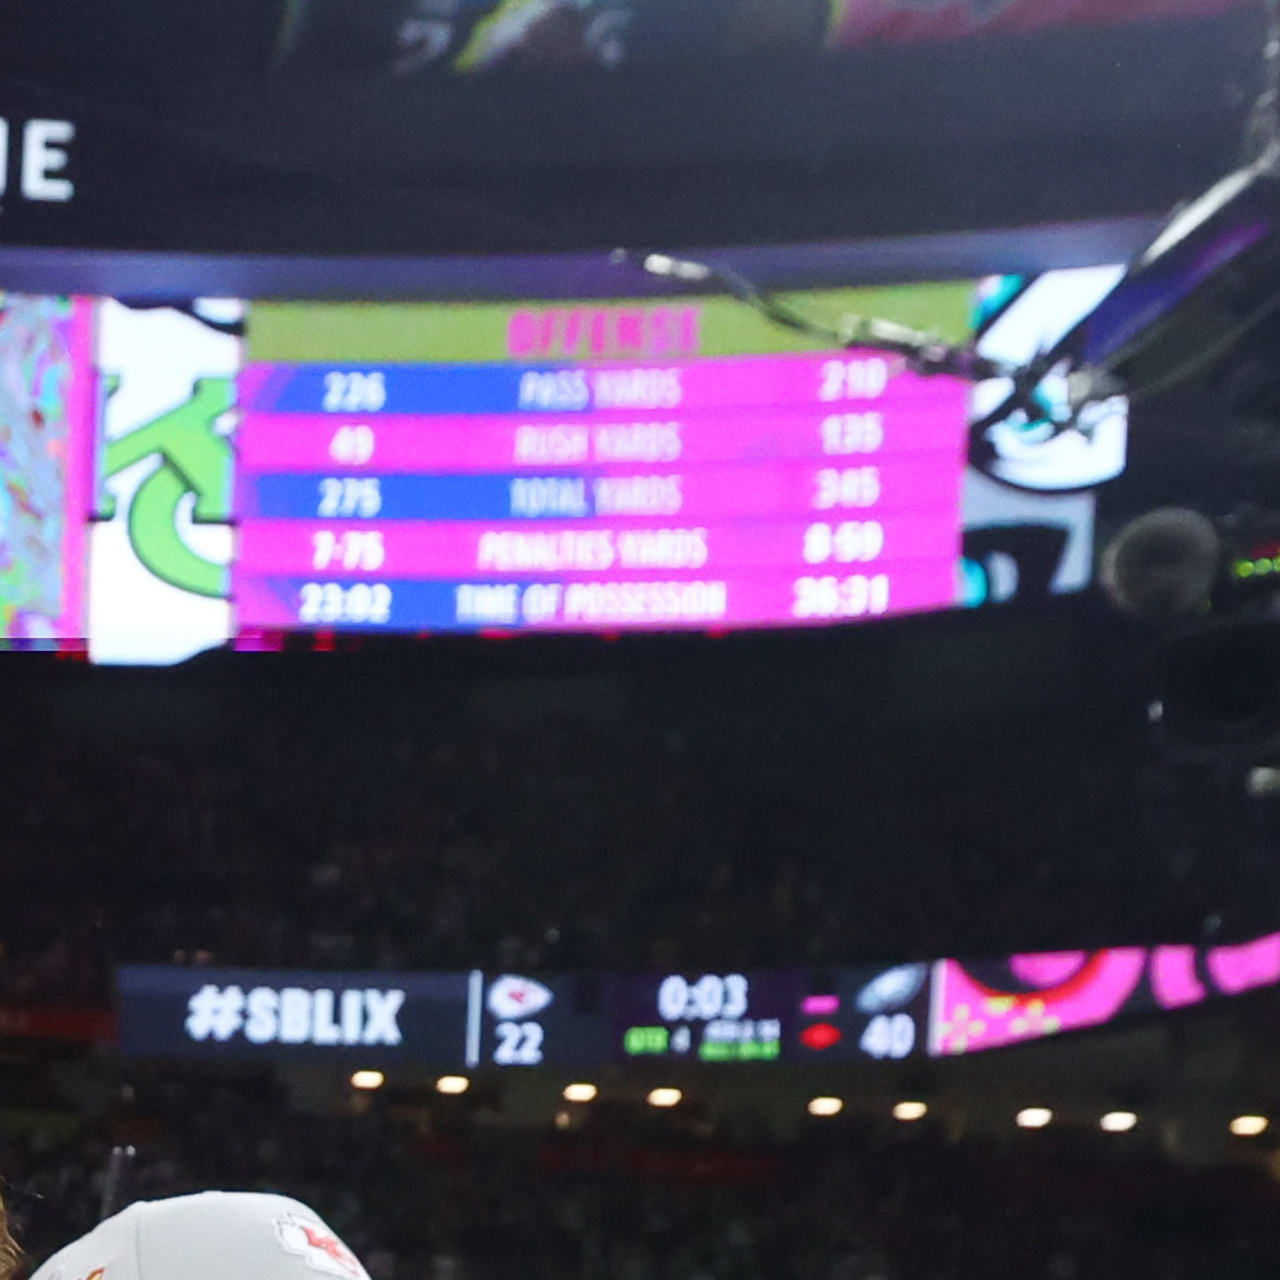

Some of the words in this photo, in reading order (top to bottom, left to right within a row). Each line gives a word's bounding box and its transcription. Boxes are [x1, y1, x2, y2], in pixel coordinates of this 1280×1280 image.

[186, 983, 407, 1046] #SBLIX
[657, 973, 749, 1021] 0:03
[493, 1021, 544, 1065] 22
[859, 1013, 916, 1060] 40
